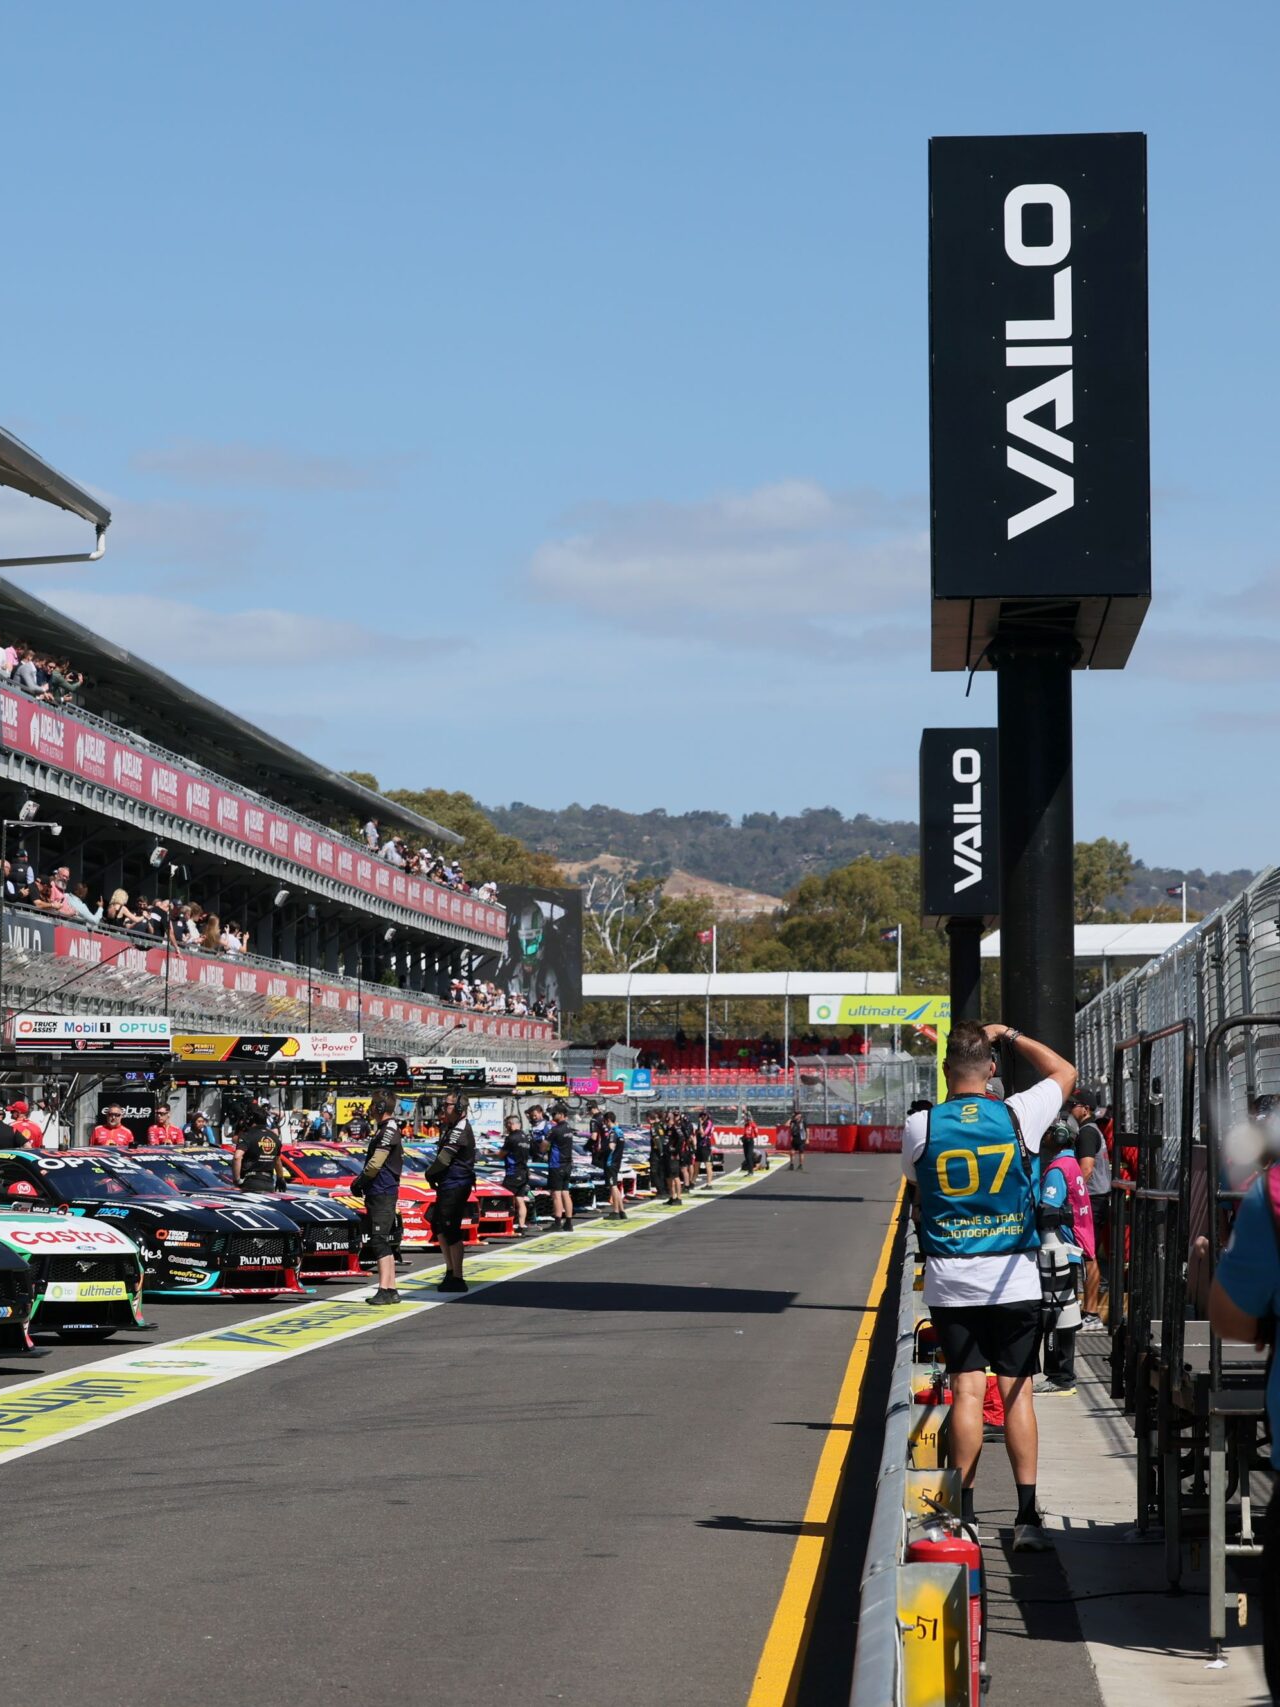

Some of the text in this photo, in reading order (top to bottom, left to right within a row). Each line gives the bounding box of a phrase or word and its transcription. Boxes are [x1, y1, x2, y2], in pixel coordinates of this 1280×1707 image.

[1004, 183, 1075, 541] VAILO
[951, 747, 982, 895] VAILO
[848, 1005, 907, 1017] ultimate
[64, 1021, 98, 1033] Mobil
[120, 1022, 167, 1033] OPTUS
[311, 1043, 353, 1051] V-Power
[101, 1105, 152, 1115] eebus
[37, 1156, 143, 1170] OPTUS
[936, 1143, 1015, 1197] 07
[96, 1207, 130, 1216] move
[306, 1202, 334, 1219] 1
[232, 1210, 263, 1228] 1
[954, 1215, 982, 1227] LANE
[984, 1215, 992, 1225] &
[10, 1229, 125, 1246] Castrol
[316, 1241, 350, 1251] PALM TRANS
[239, 1256, 282, 1266] PALM TRANS
[79, 1284, 123, 1297] ultimate
